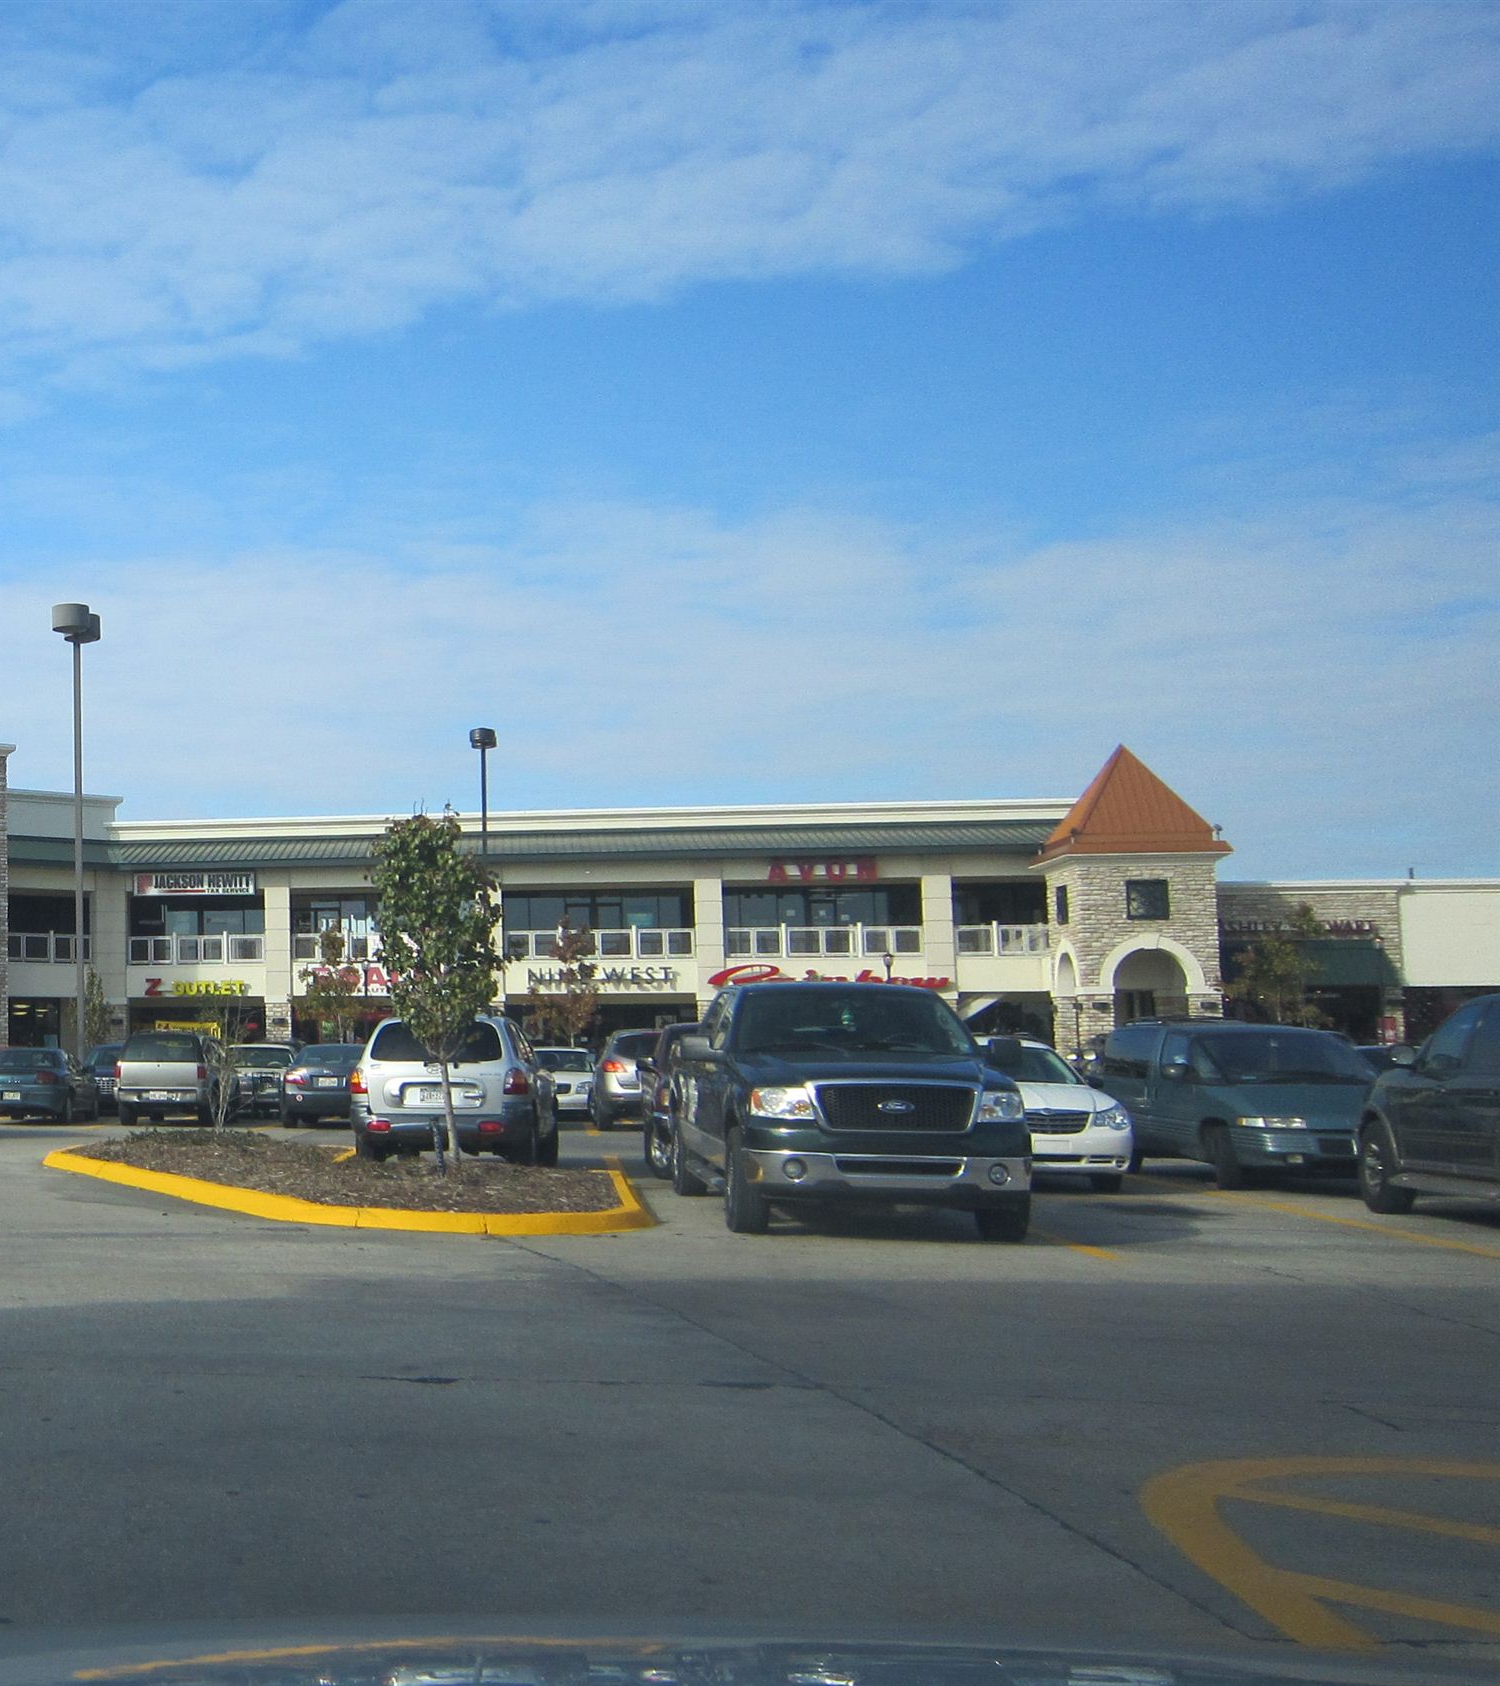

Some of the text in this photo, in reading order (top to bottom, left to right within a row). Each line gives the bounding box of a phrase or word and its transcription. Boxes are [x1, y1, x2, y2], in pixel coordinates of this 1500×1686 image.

[768, 857, 879, 881] AVON
[153, 873, 251, 889] JACKSON HEWITT
[527, 966, 674, 985] NIN WEST
[144, 977, 245, 996] Z OUTLET
